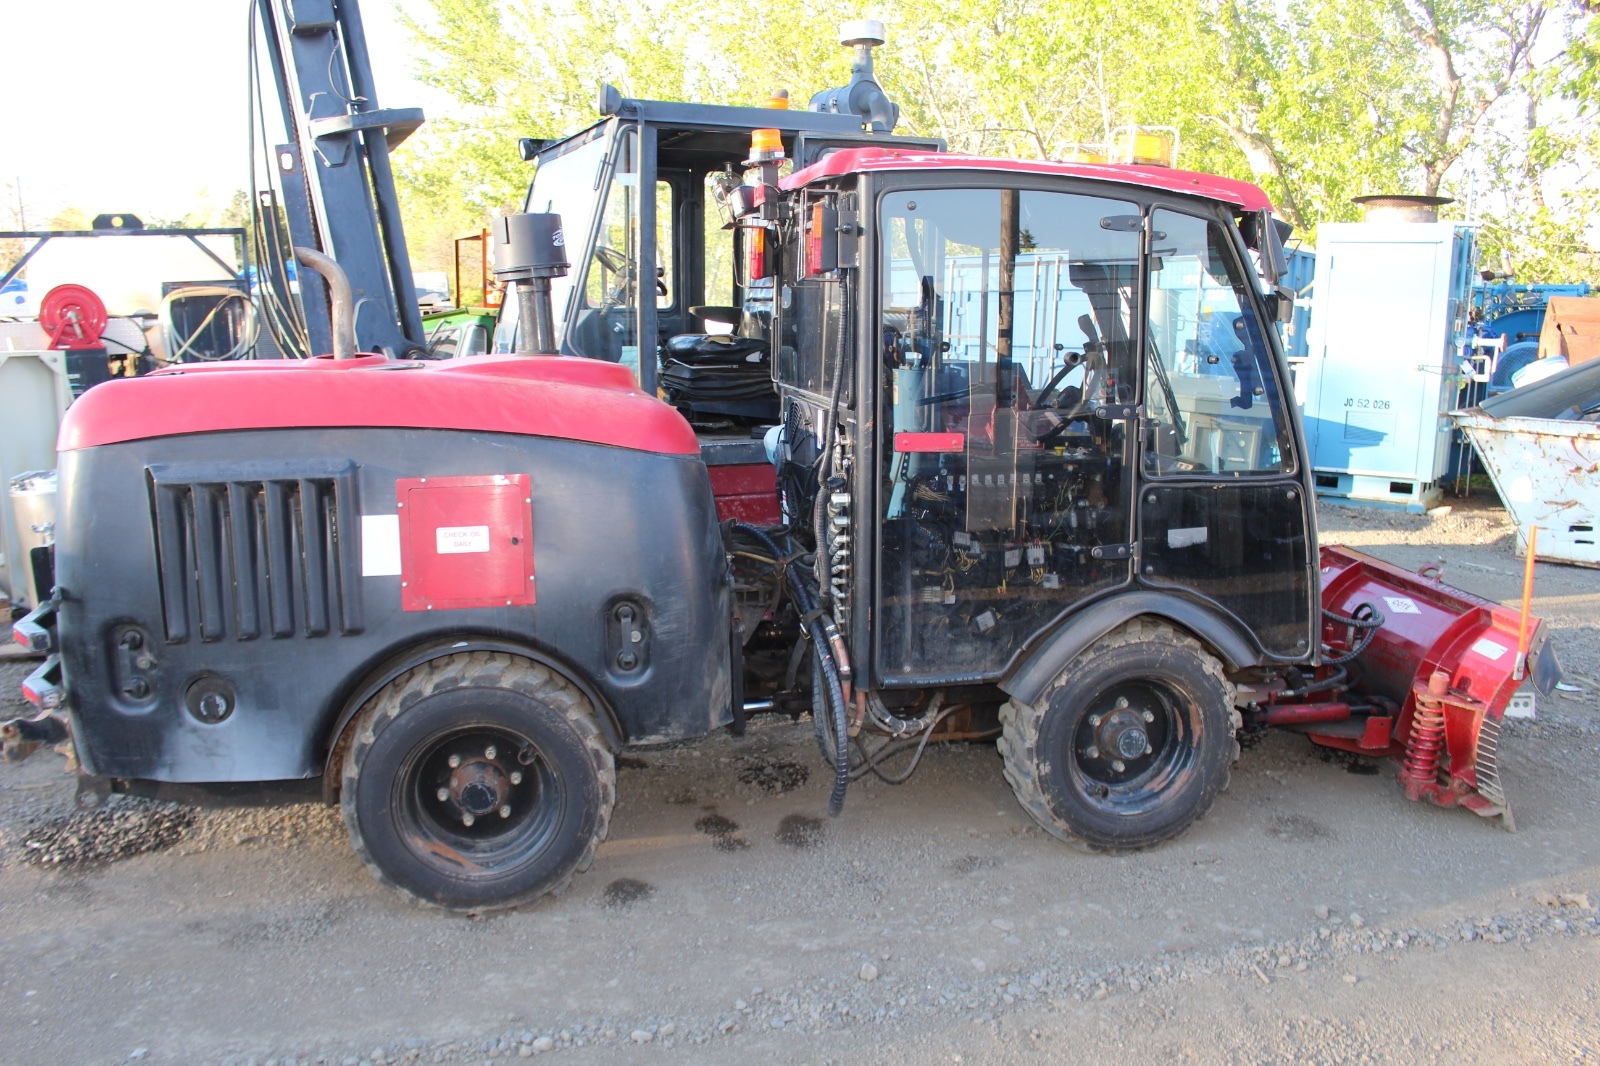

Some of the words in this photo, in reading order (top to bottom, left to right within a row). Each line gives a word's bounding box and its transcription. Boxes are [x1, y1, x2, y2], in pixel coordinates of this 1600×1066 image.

[1357, 398, 1370, 408] 52
[1373, 400, 1390, 409] 026
[444, 531, 467, 539] CHECK
